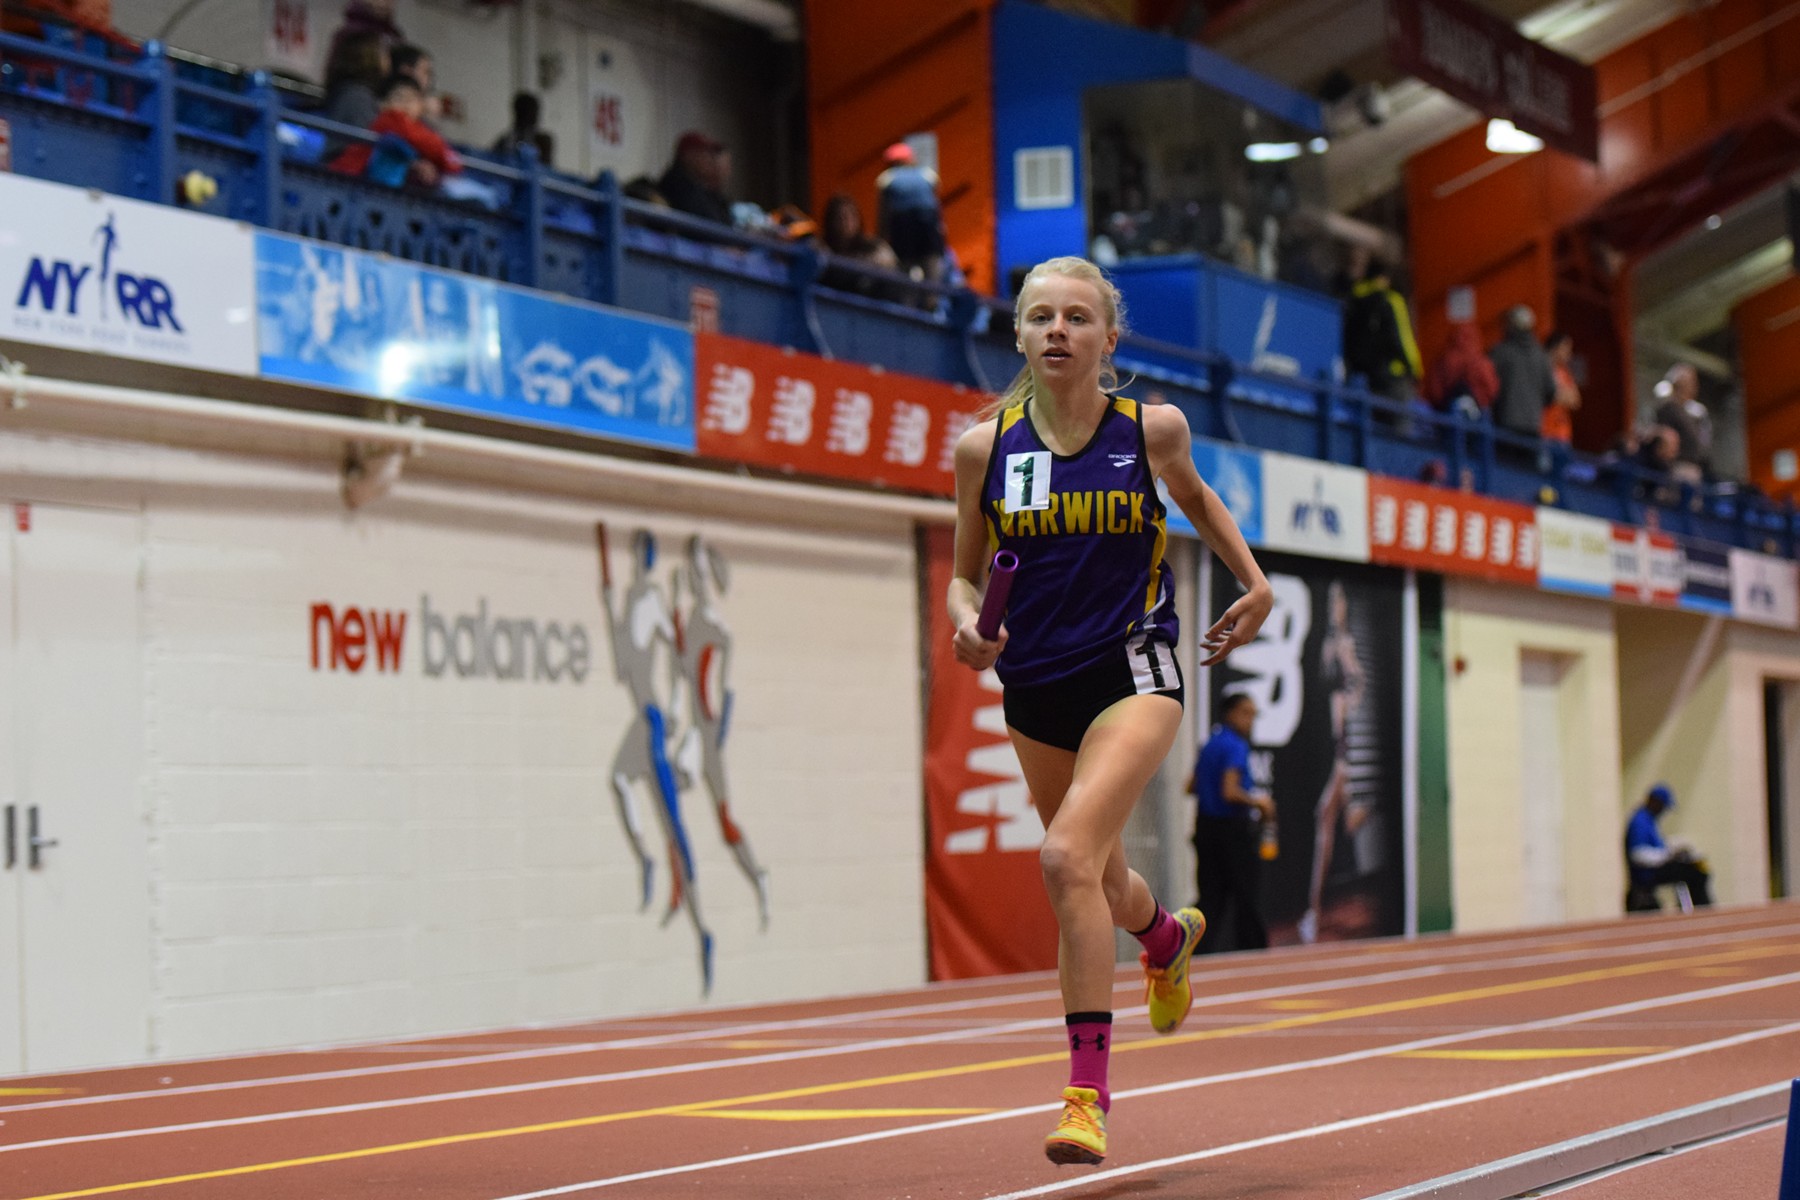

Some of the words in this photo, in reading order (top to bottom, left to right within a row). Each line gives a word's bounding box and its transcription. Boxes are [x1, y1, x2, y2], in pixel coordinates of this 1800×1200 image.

[1013, 456, 1035, 507] 1
[308, 602, 408, 674] new
[420, 593, 590, 683] balance
[1134, 632, 1166, 689] 1
